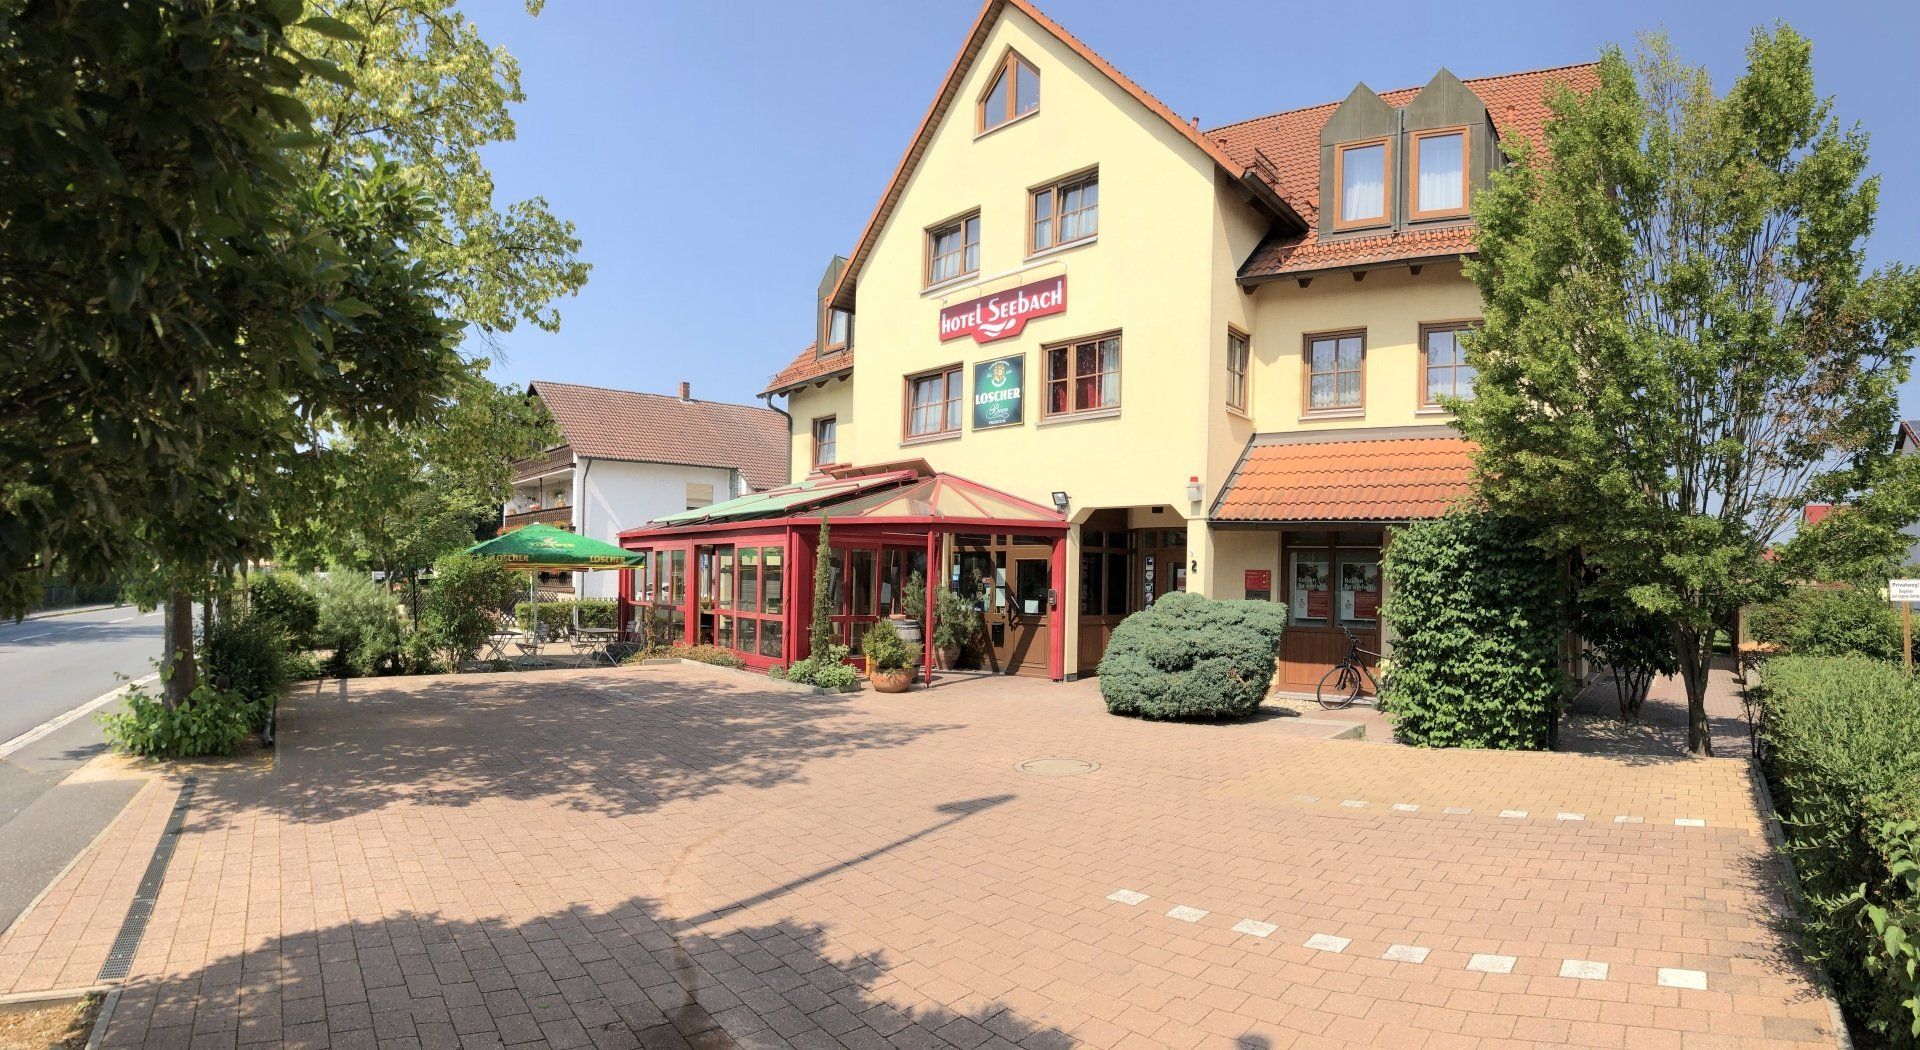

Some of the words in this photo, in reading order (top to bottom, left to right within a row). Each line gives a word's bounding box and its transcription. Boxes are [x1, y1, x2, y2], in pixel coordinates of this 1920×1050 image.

[975, 387, 1021, 405] LOSCHER
[589, 555, 626, 564] LOSCHER
[1191, 560, 1198, 573] 2
